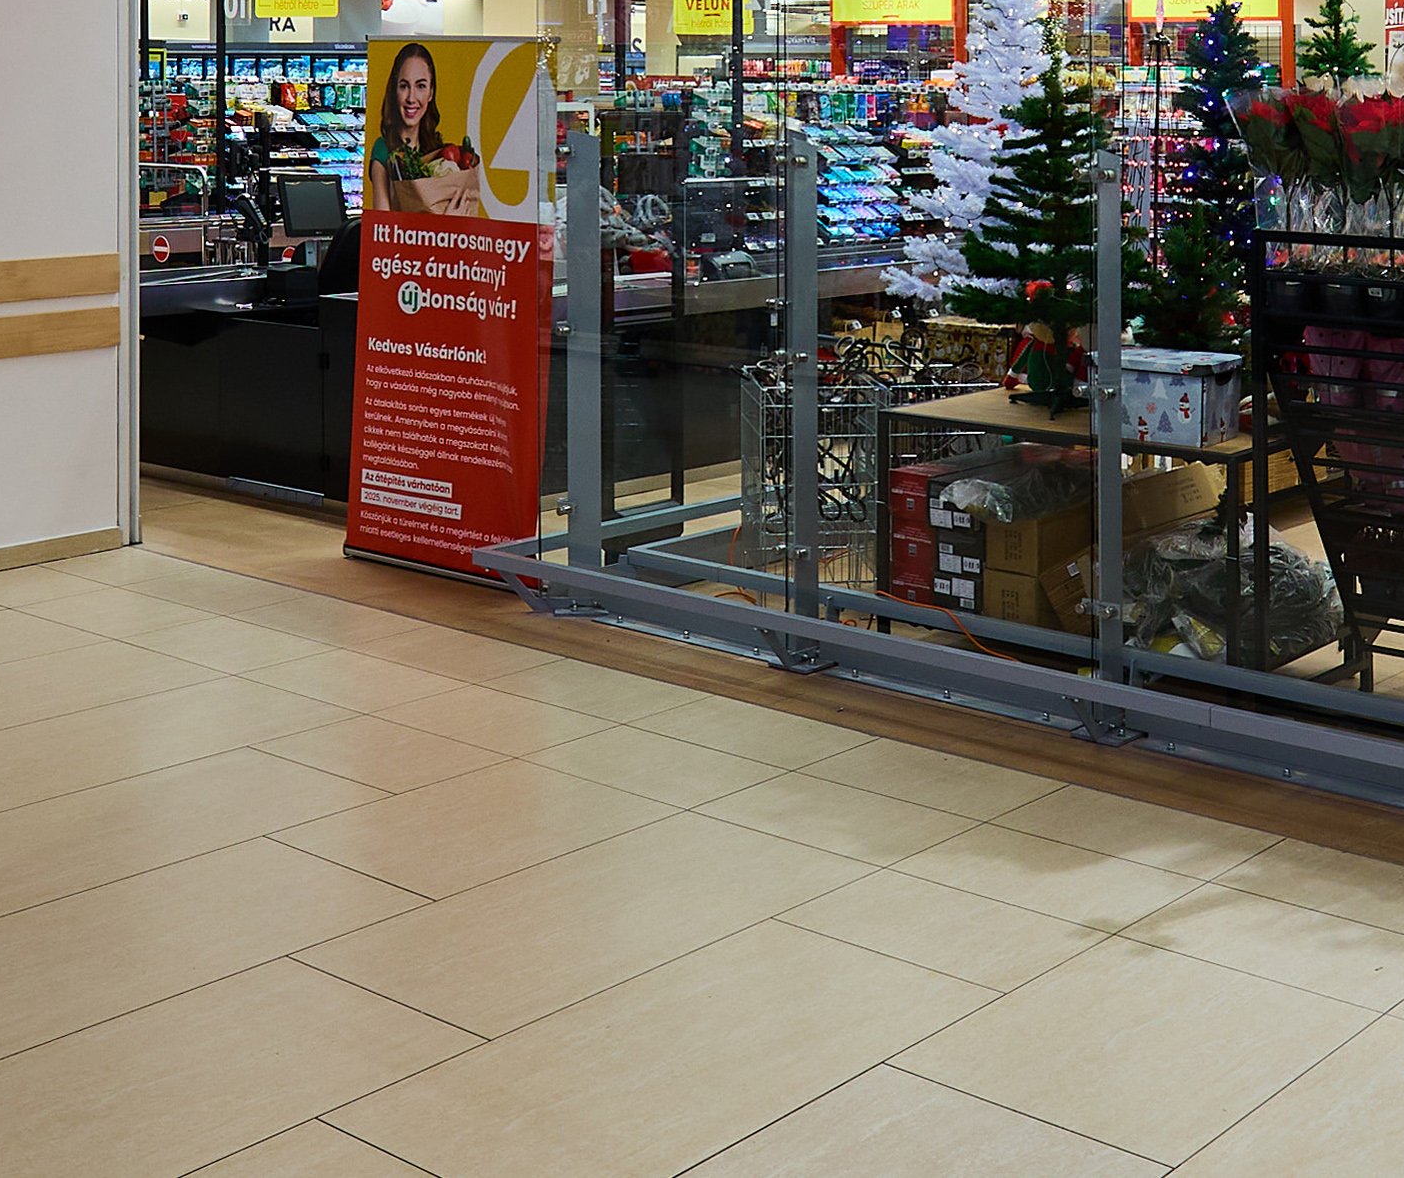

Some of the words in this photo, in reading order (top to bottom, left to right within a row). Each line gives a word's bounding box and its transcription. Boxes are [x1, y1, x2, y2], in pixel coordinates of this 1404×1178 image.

[373, 223, 391, 243] Itt
[393, 224, 493, 253] hamarosan
[495, 238, 531, 263] egy
[372, 253, 422, 280] egész
[425, 256, 506, 291] áruháznyi
[401, 284, 487, 320] újdonság
[488, 296, 517, 320] vár!
[368, 336, 413, 356] Kedves
[414, 342, 487, 365] Vásárlónk!
[366, 364, 374, 373] Az
[374, 365, 414, 378] elkövetkező
[414, 369, 456, 383] időszakban
[366, 378, 382, 390] hogy
[389, 381, 419, 393] vásárlás
[420, 386, 438, 398] még
[438, 387, 473, 400] nagyobb
[365, 397, 373, 406] Az
[373, 398, 407, 411] átalakítás
[408, 402, 429, 414] során
[429, 405, 452, 418] egyes
[452, 408, 488, 422] termékek
[394, 415, 439, 430] Amennyiben
[364, 425, 384, 436] cikkek
[384, 429, 402, 438] nem
[402, 430, 438, 445] találhatók
[439, 437, 445, 445] a
[437, 448, 460, 462] állnak
[364, 472, 375, 483] Az
[375, 473, 406, 489] átépítés
[407, 478, 451, 495] várhatóan
[383, 494, 417, 509] november
[418, 500, 444, 516] végéig
[444, 505, 460, 517] tart.
[360, 510, 392, 526] Köszönjük
[399, 517, 430, 531] türelmet
[430, 523, 439, 533] és
